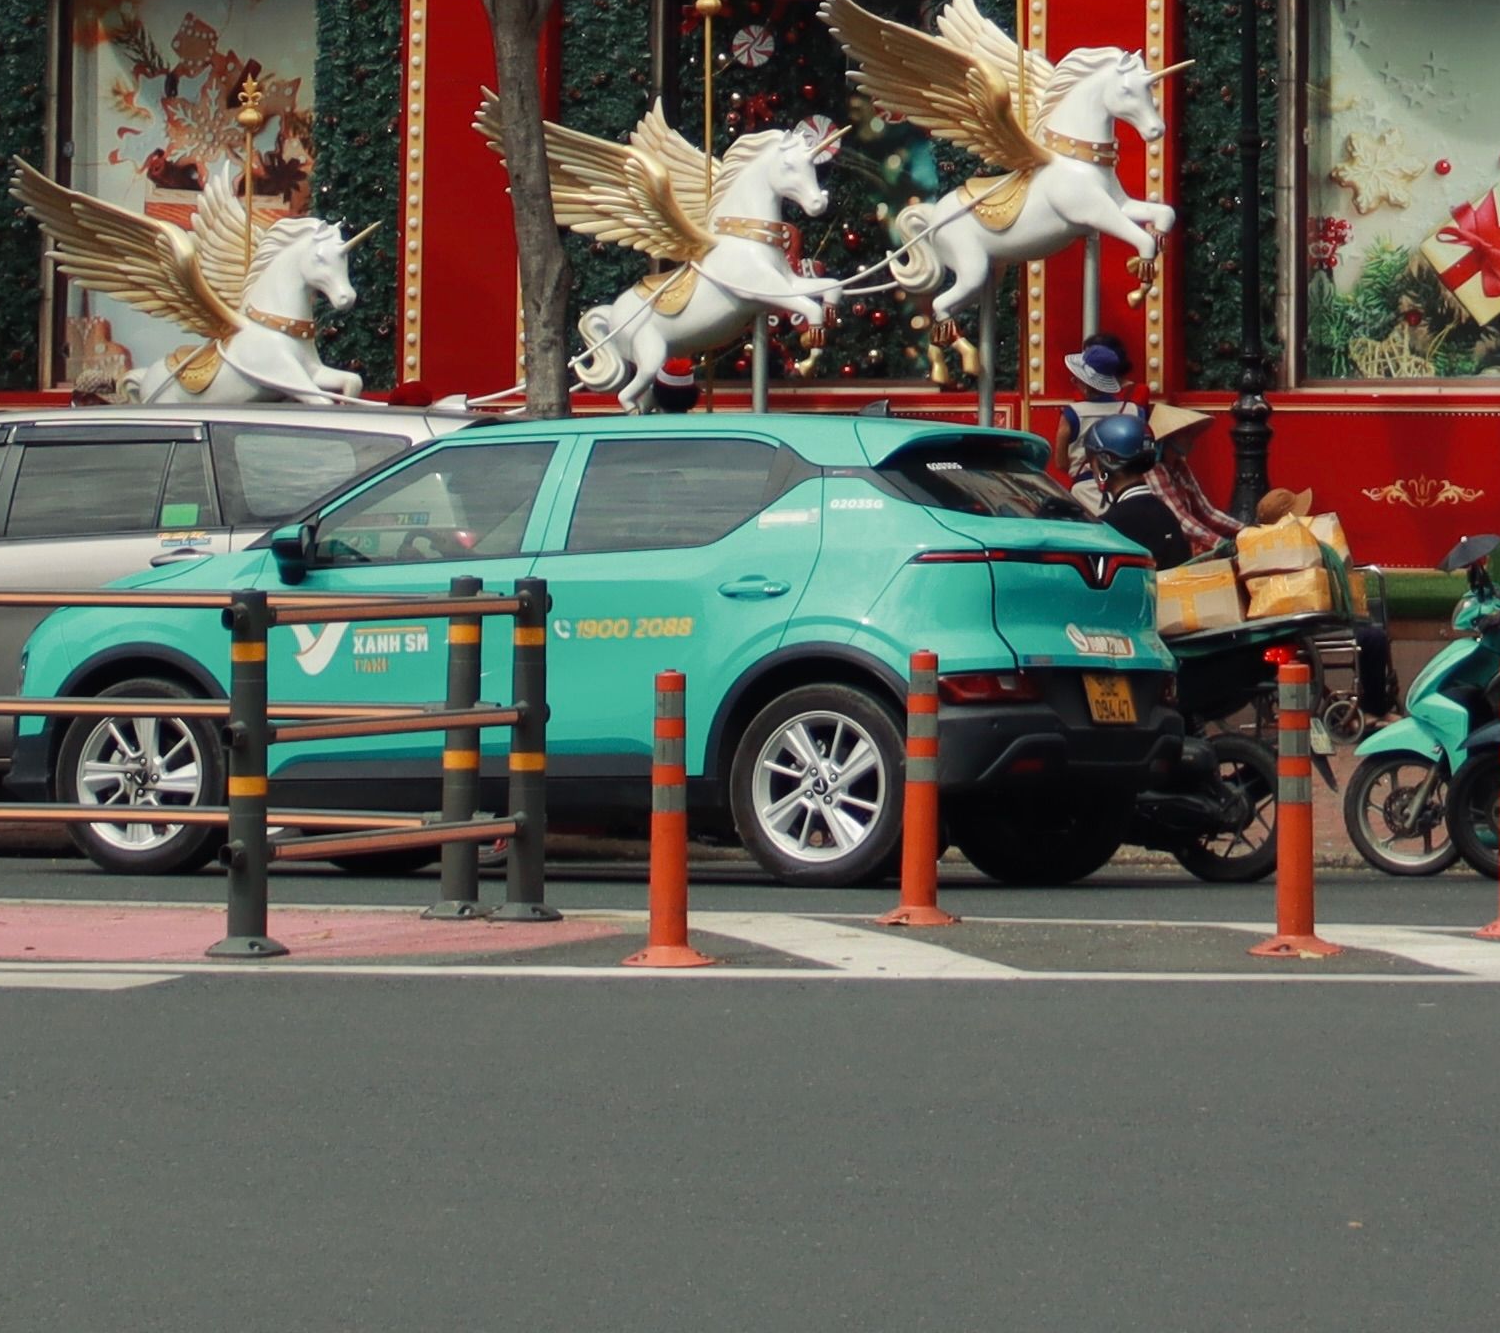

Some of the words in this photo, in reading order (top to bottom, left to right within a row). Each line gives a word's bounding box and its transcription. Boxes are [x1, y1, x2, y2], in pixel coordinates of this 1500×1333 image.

[576, 619, 629, 639] 1900
[633, 617, 693, 638] 2088
[353, 634, 401, 654] XANH
[404, 632, 429, 652] SM
